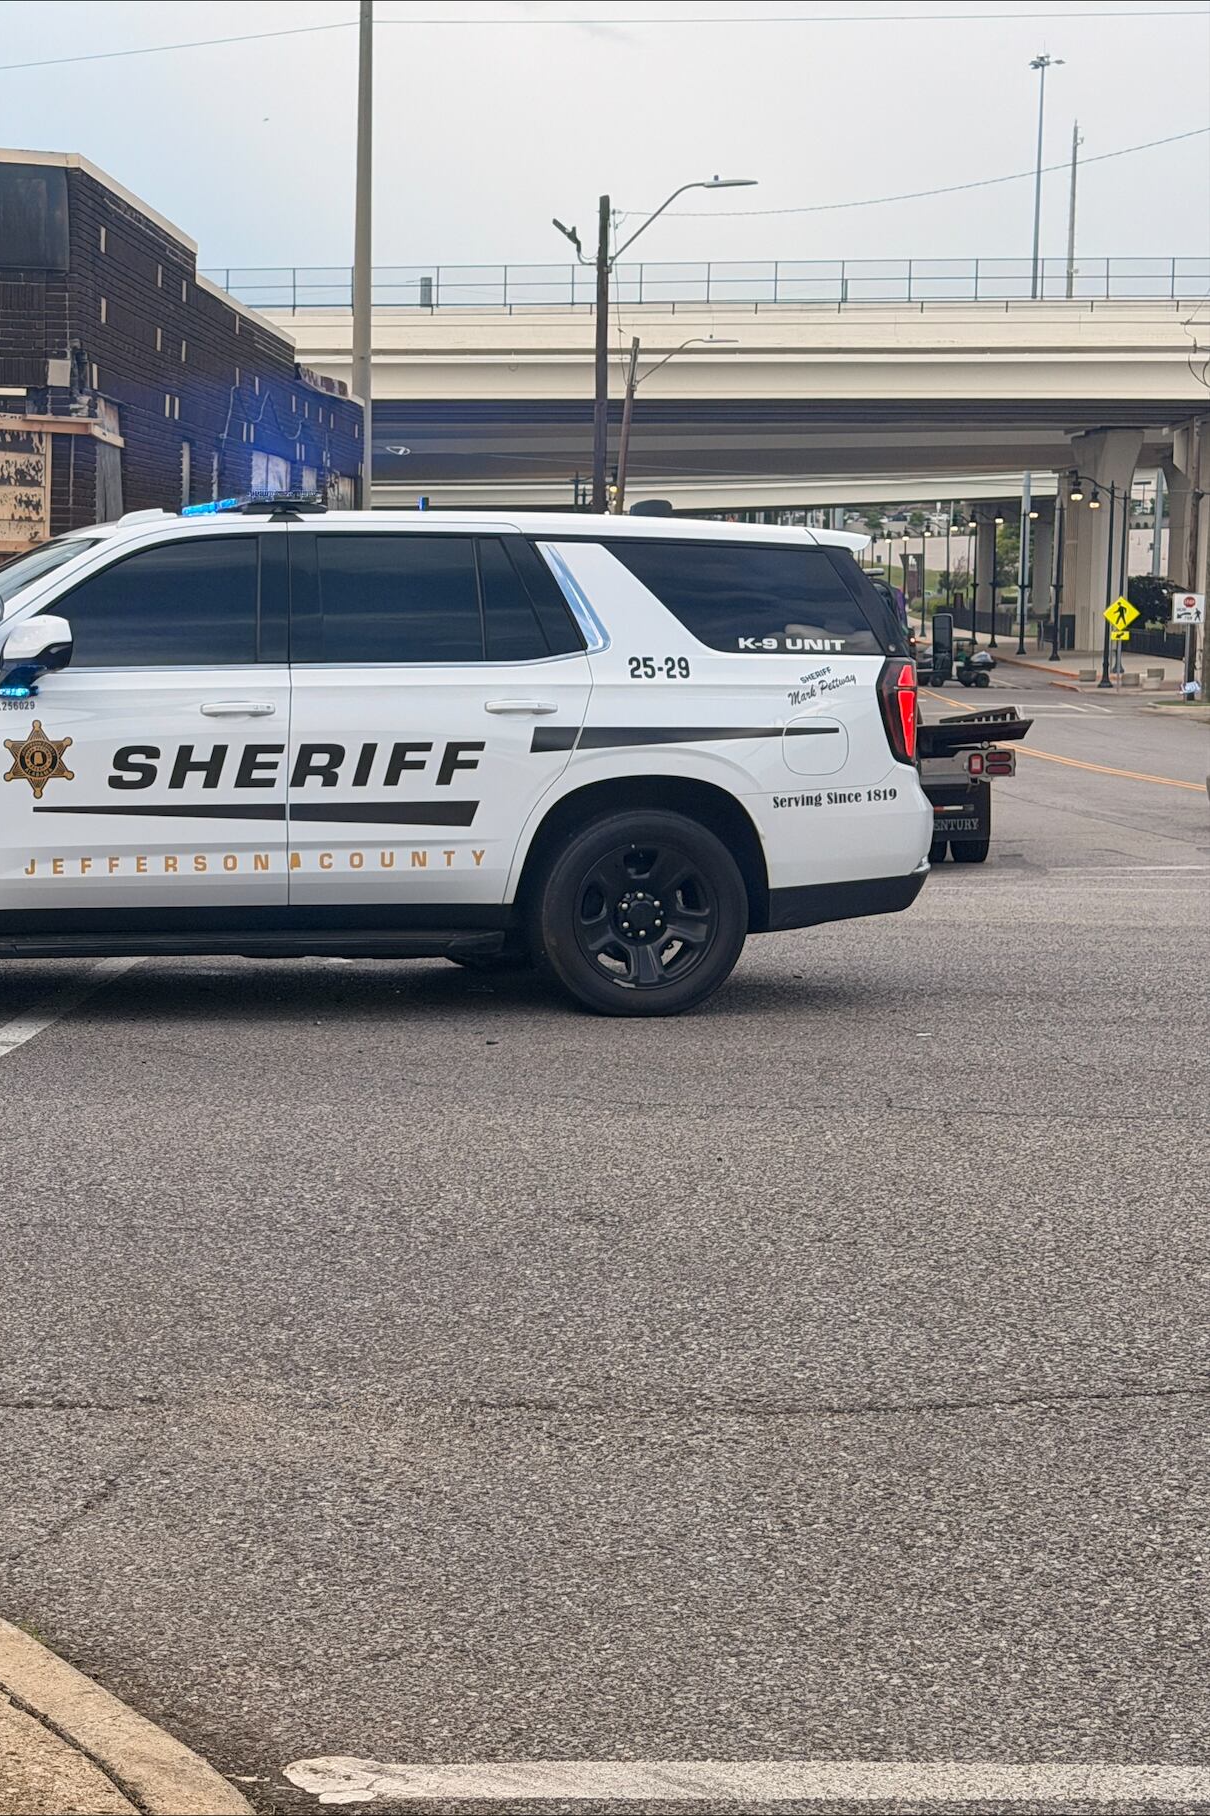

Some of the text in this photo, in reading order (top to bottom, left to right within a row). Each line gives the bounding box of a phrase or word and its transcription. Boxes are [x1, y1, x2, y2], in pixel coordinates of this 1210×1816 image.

[738, 637, 846, 651] K-9 UNIT
[628, 656, 690, 679] 25-29
[799, 665, 832, 684] SHERIFF
[787, 672, 857, 706] Mark Pettway
[107, 740, 487, 791] SHERIFF
[772, 788, 898, 808] Serving Since 1819
[933, 817, 979, 831] ENTURY
[24, 849, 486, 876] JEFFERSON COUNTY
